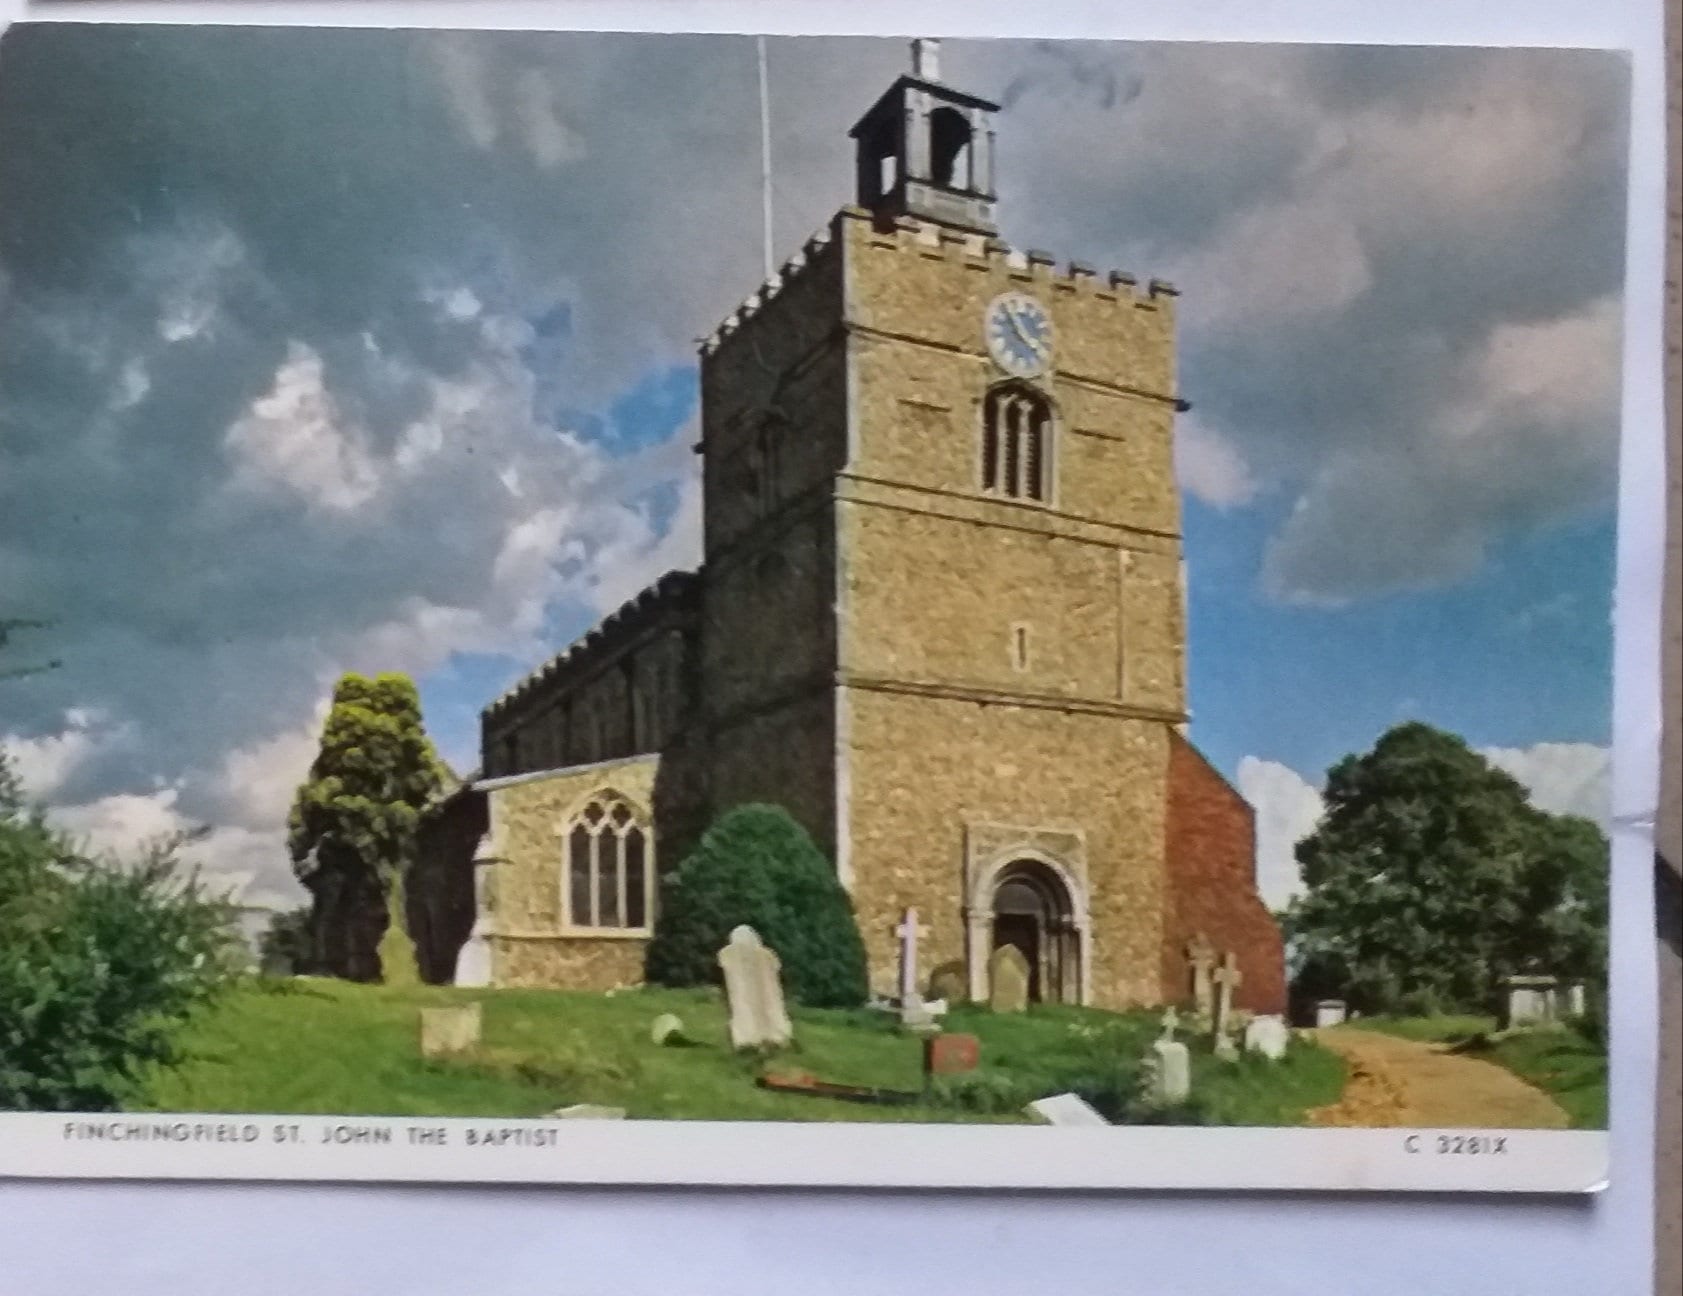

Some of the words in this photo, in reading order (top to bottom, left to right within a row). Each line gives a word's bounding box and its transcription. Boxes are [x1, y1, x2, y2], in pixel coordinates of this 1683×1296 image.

[63, 1122, 259, 1143] FINCHINGFIELD
[273, 1125, 304, 1143] ST.
[321, 1125, 391, 1144] JOHN
[407, 1127, 447, 1145] THE
[465, 1127, 558, 1146] BAPTIST
[1404, 1135, 1420, 1154] C
